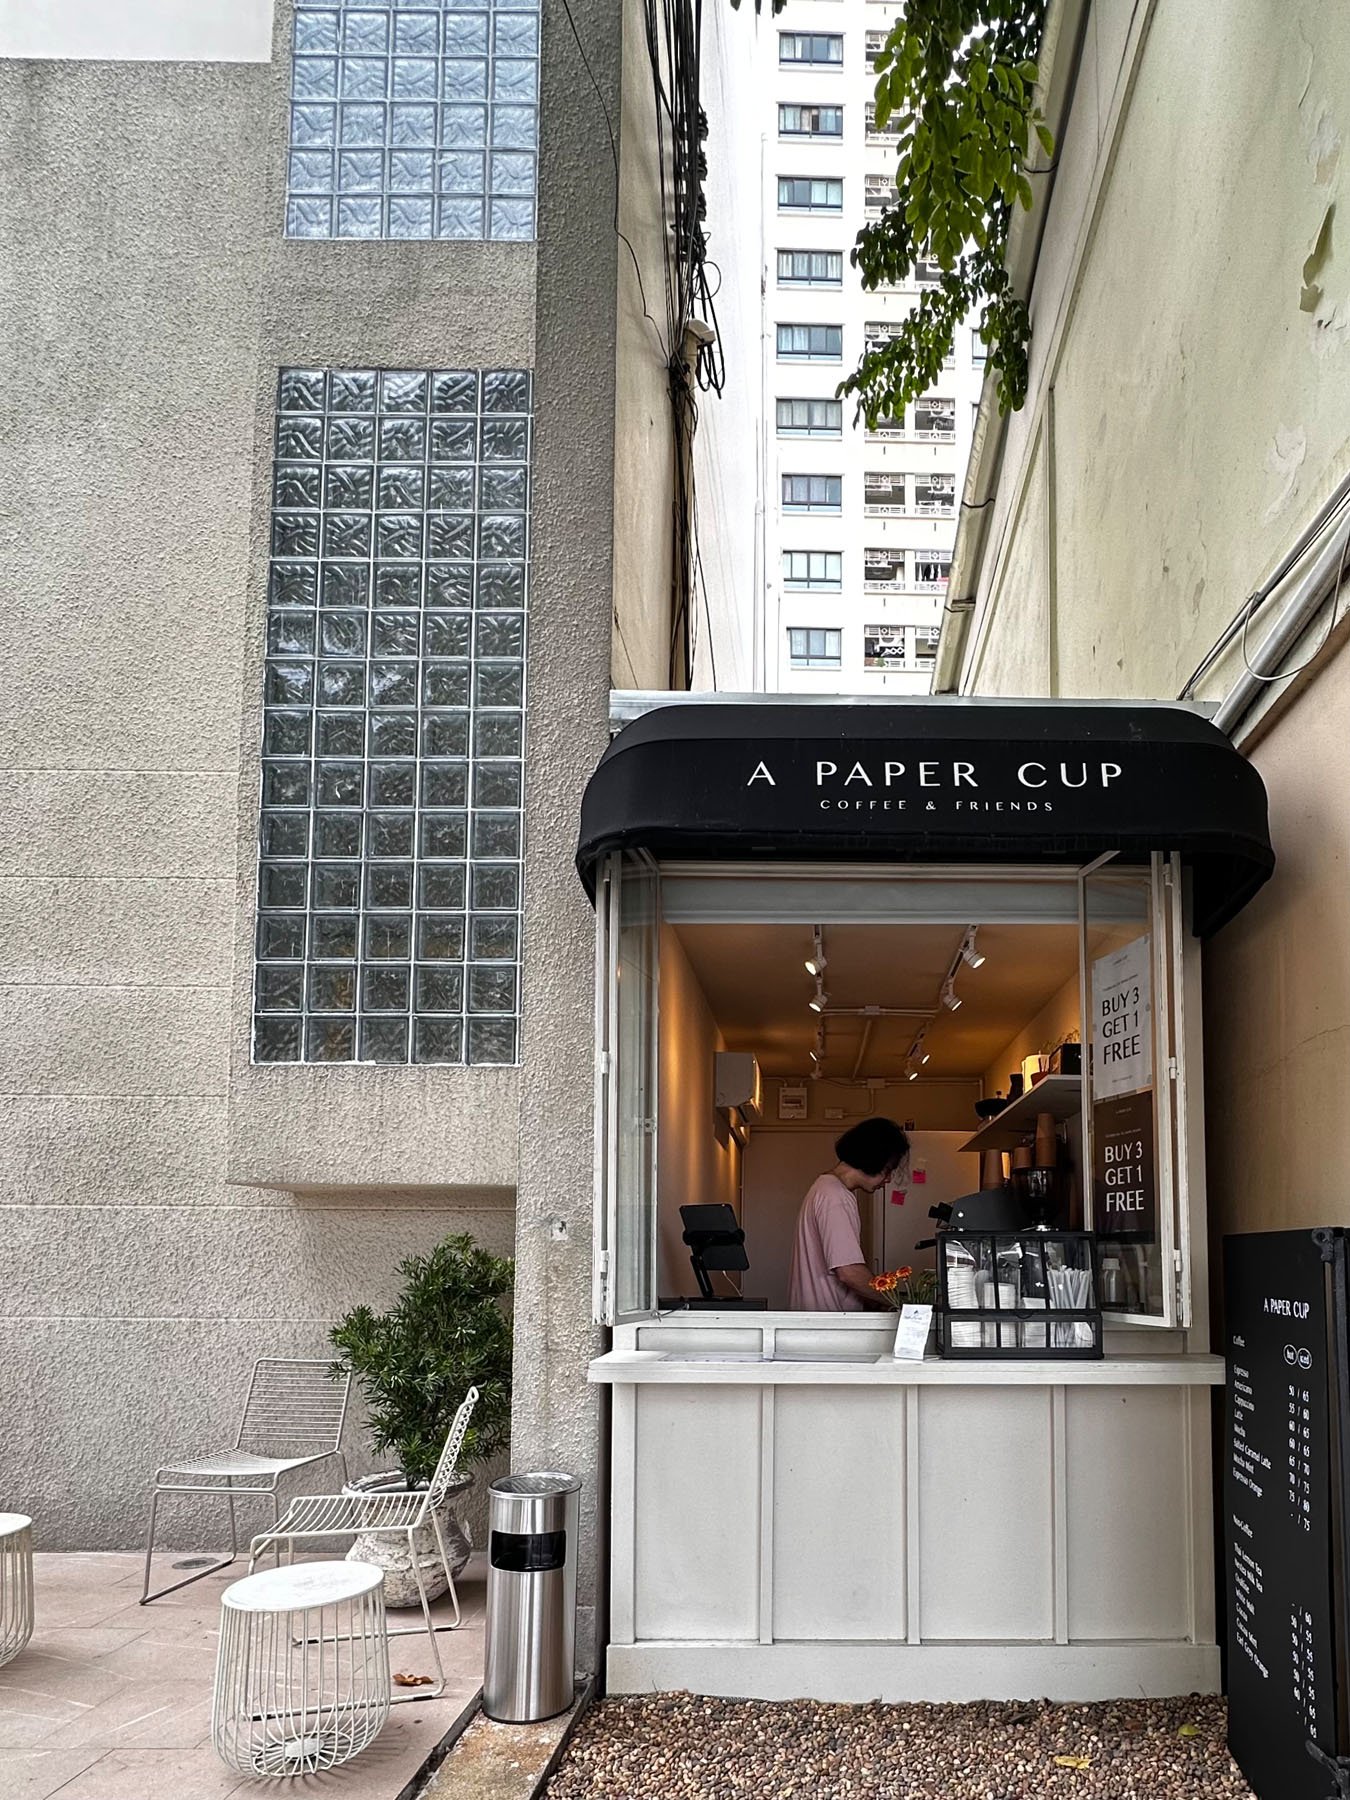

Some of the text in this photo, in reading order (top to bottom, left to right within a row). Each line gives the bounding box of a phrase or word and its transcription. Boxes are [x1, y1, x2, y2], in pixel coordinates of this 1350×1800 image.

[747, 761, 1123, 788] A PAPER CUP
[820, 799, 1053, 812] COFFEE & FRIENDS
[1102, 986, 1140, 1017] BUY 3
[1102, 1009, 1139, 1039] GET 1
[1103, 1034, 1141, 1065] FREE
[1104, 1140, 1143, 1163] BUY 3
[1105, 1164, 1142, 1186] GET 1
[1106, 1190, 1145, 1213] FREE
[1264, 1298, 1310, 1319] A PAPER CUP
[1303, 1481, 1310, 1494] 75
[1303, 1518, 1310, 1531] 75
